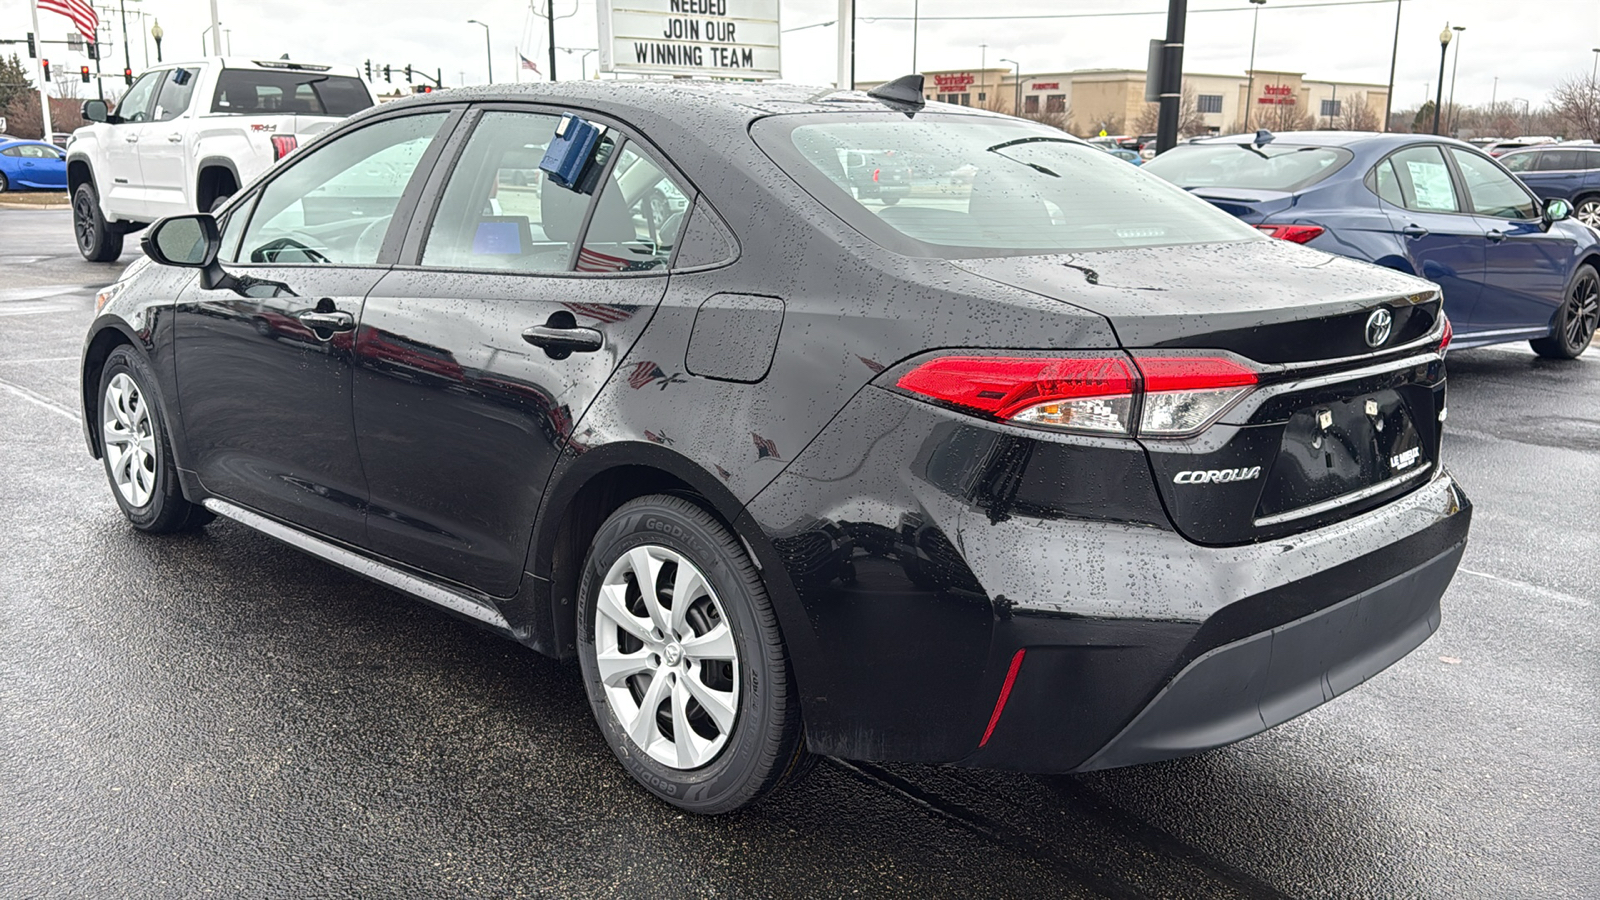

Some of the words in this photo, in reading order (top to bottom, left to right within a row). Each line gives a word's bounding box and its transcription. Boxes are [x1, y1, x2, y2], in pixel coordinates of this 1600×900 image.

[670, 0, 726, 16] NEEDED
[664, 18, 699, 40] JOIN
[706, 21, 736, 43] OUR
[634, 42, 703, 67] WINNING
[710, 47, 754, 68] TEAM
[1173, 465, 1261, 485] COROLLA
